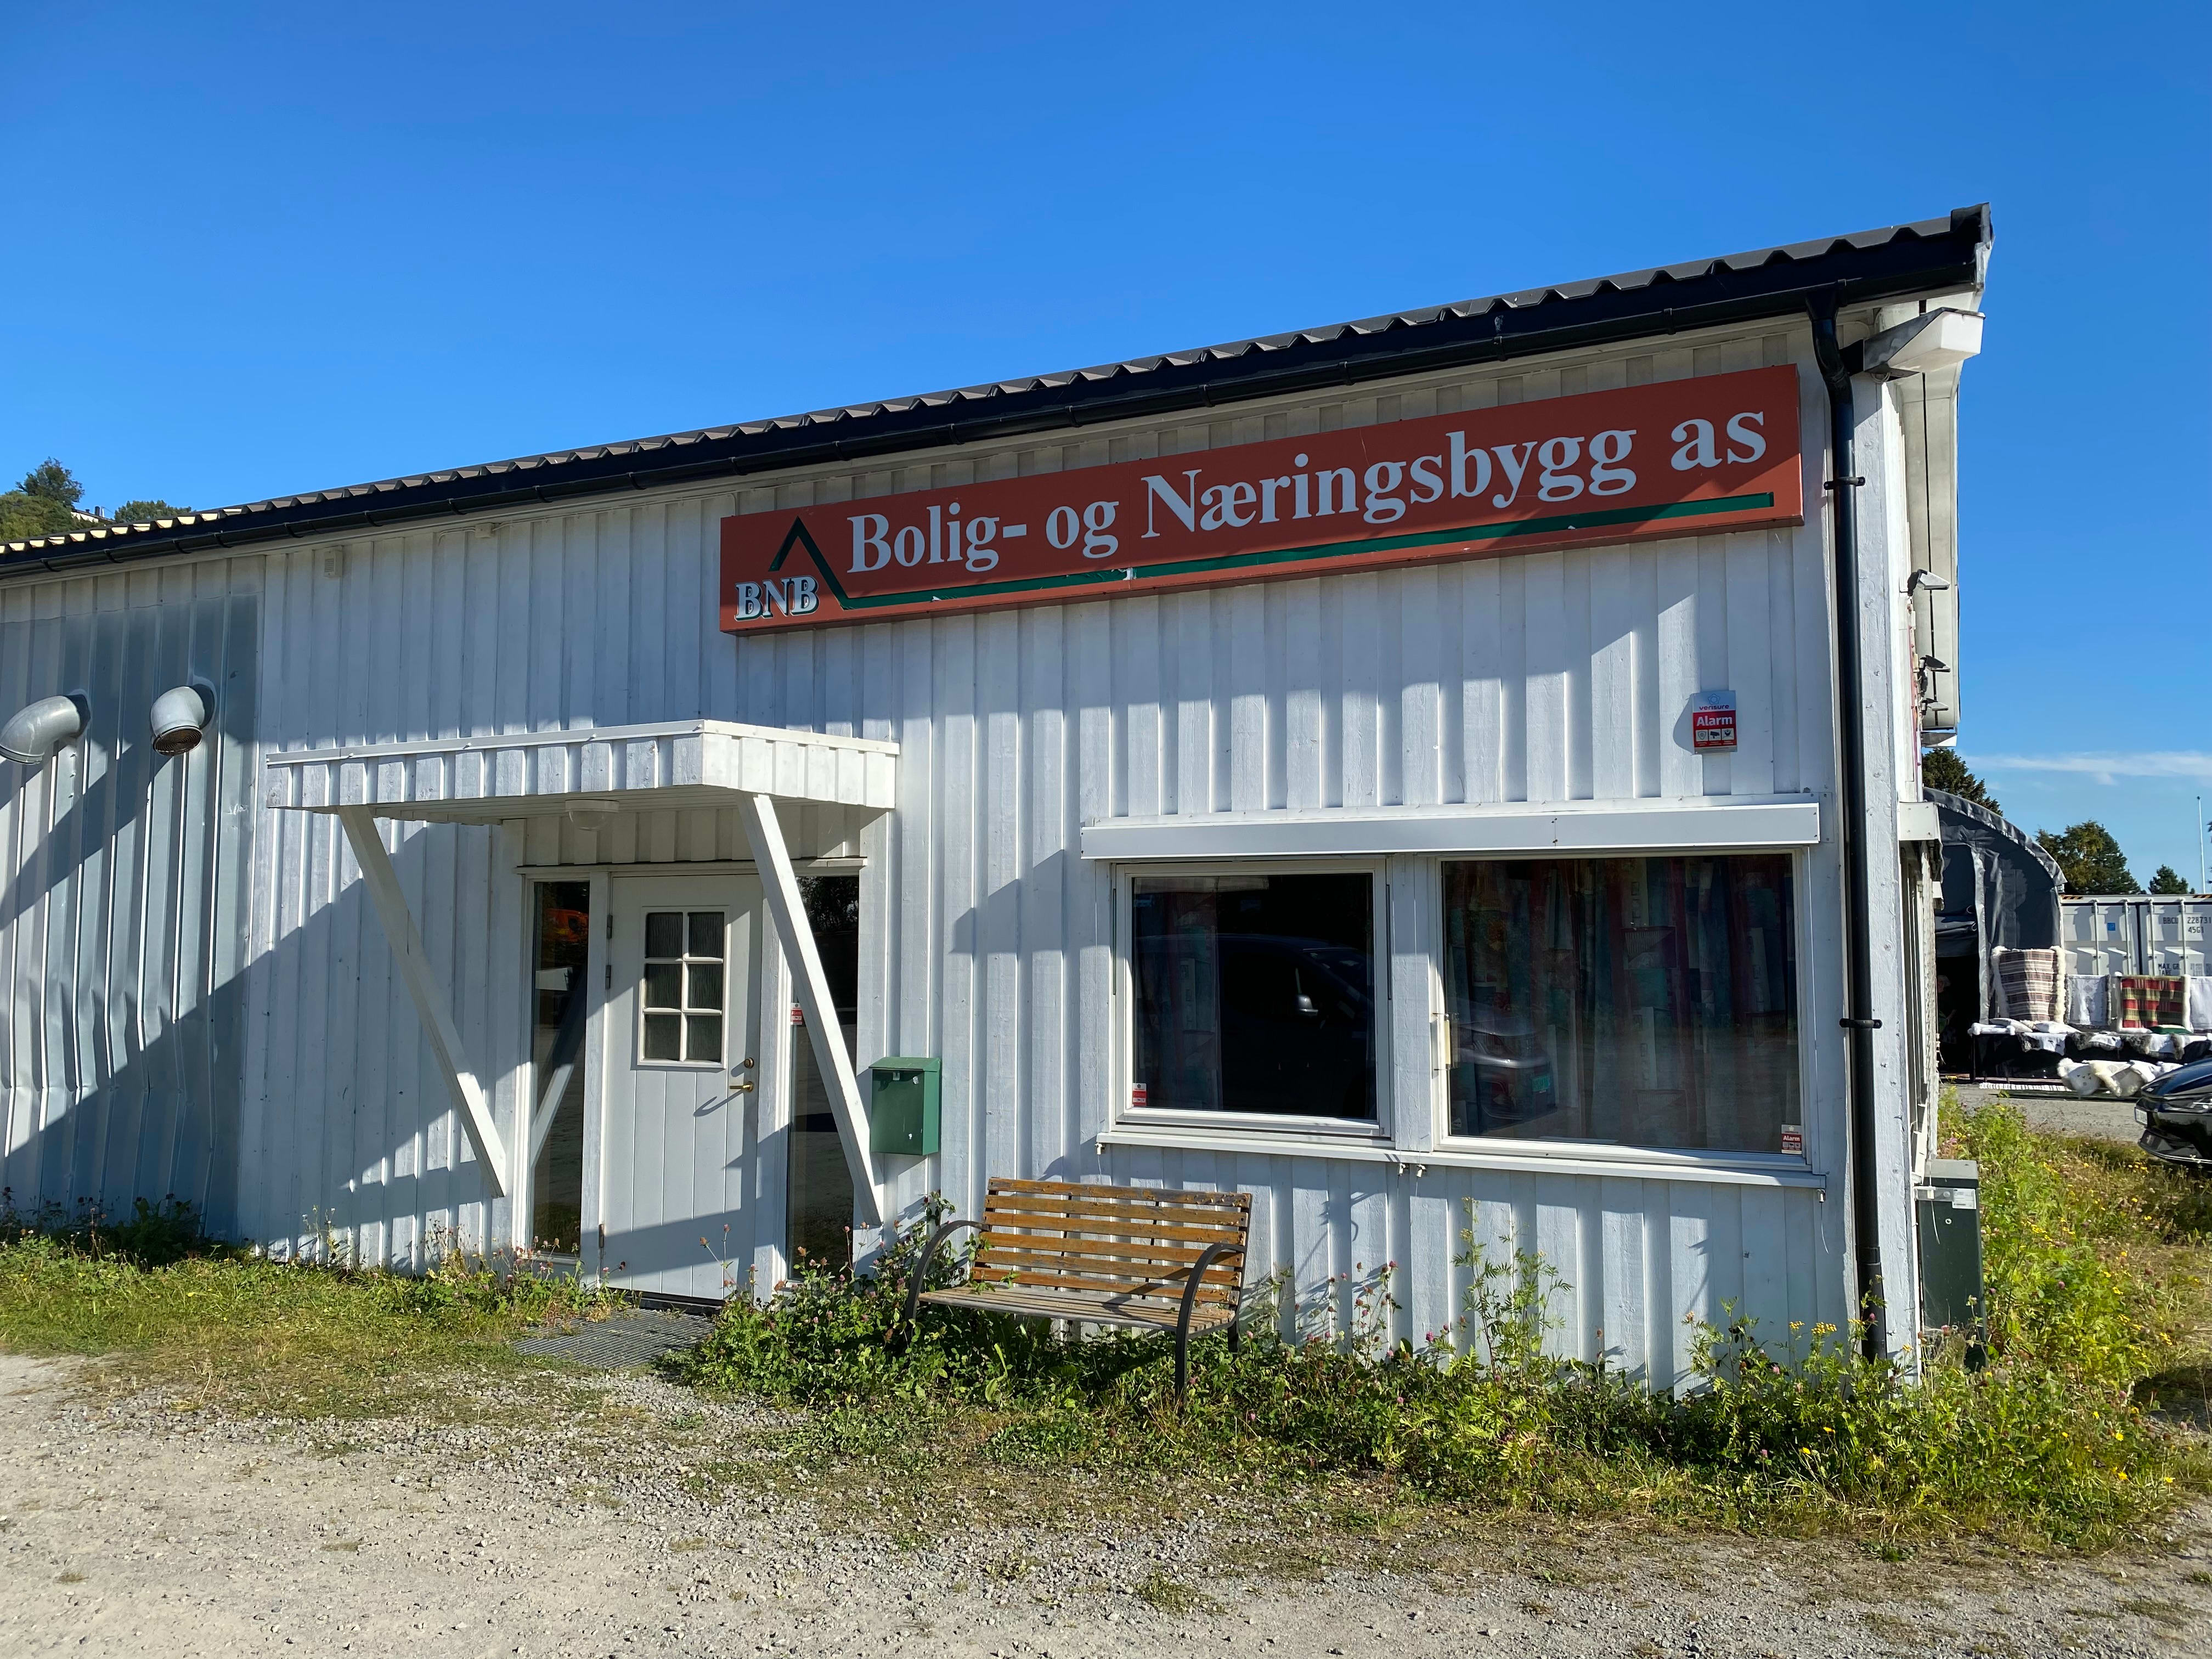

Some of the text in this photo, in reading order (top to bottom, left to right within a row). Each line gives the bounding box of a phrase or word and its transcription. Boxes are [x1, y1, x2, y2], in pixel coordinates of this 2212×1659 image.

[847, 411, 1767, 572] Bolig- og Næringsbygg as
[735, 575, 819, 622] BNB
[1696, 715, 1733, 727] Alarm
